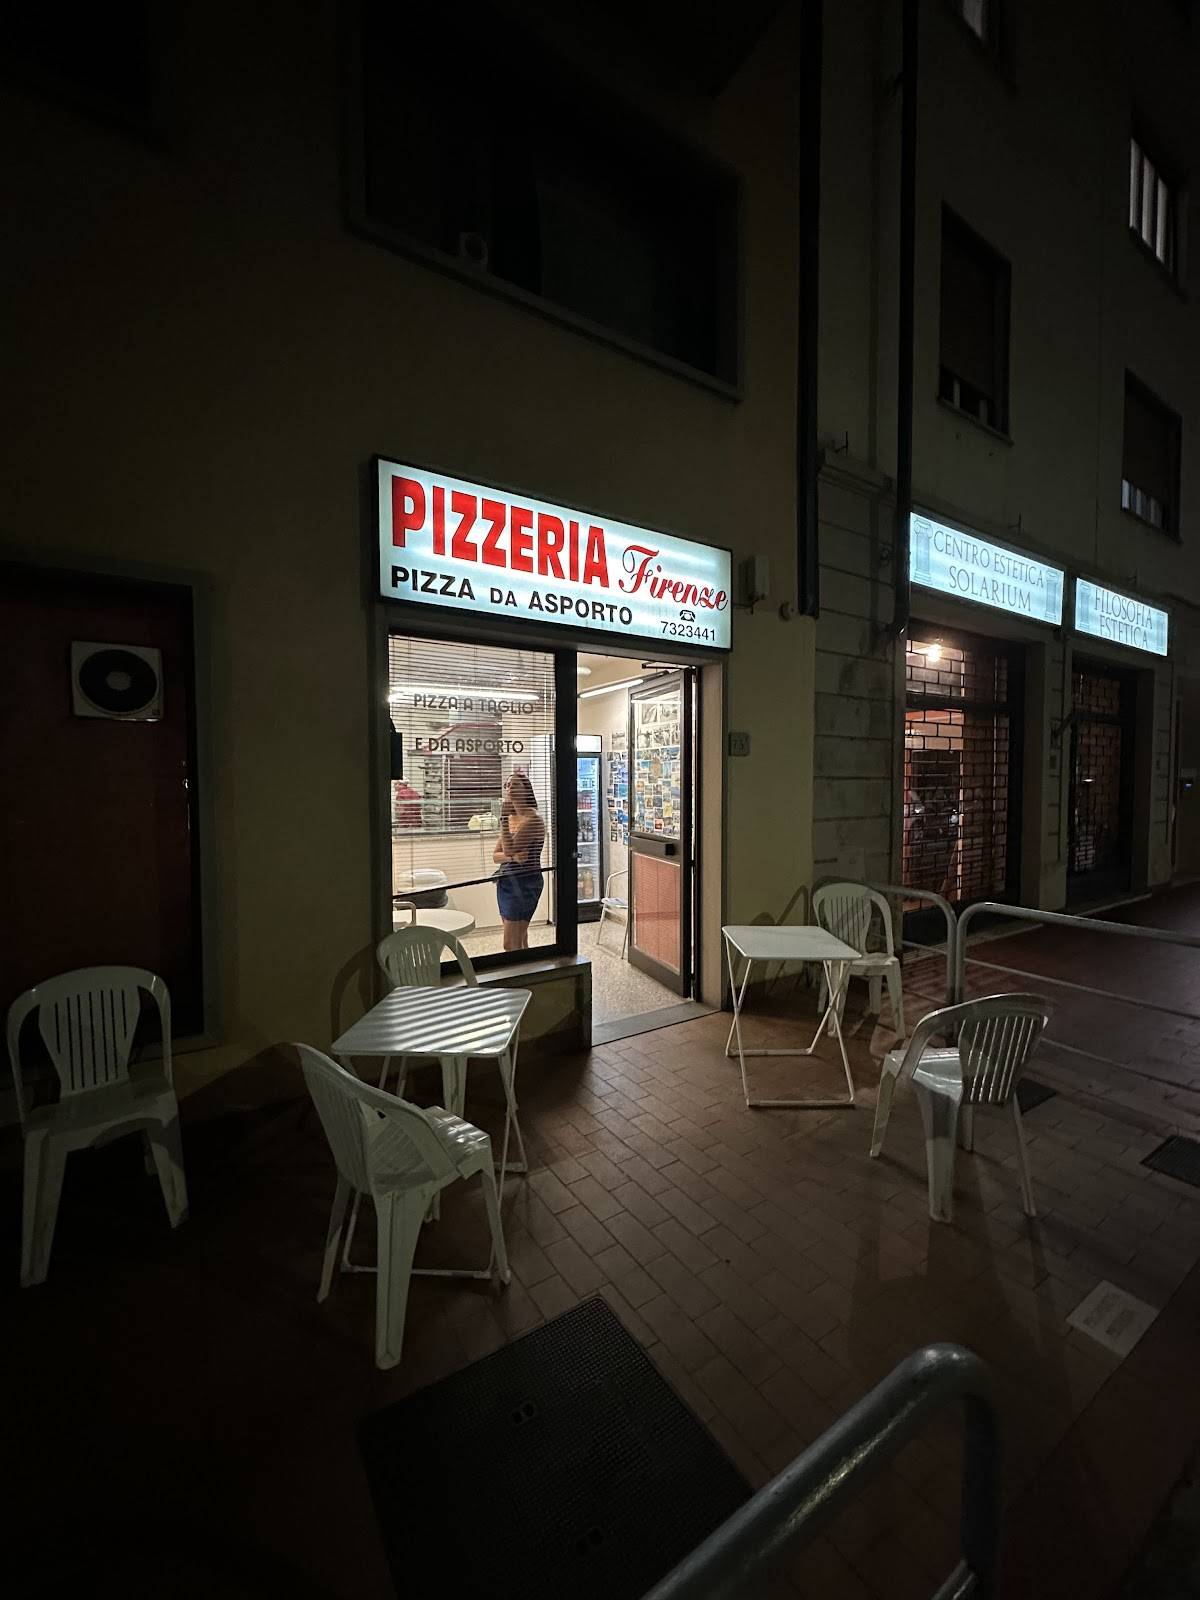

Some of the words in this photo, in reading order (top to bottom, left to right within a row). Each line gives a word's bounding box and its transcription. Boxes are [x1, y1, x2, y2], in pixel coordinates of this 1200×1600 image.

[391, 474, 610, 588] PIZZERIA
[618, 544, 728, 611] Firenze
[933, 530, 990, 568] CENTRO
[994, 553, 1044, 589] ESTETICA
[391, 565, 476, 600] PIZZA
[489, 588, 518, 607] DA
[528, 590, 633, 625] ASPORTO
[949, 565, 1031, 612] SOLARIUM
[1094, 587, 1153, 629] FILOSOFIA
[660, 621, 717, 641] 7323441
[1100, 615, 1148, 649] ESTETICA
[413, 693, 458, 710] PIZZA
[463, 697, 473, 711] A
[479, 699, 534, 715] TAGLIO
[415, 737, 423, 751] E
[428, 738, 450, 752] DA
[455, 738, 524, 754] ASPORTO
